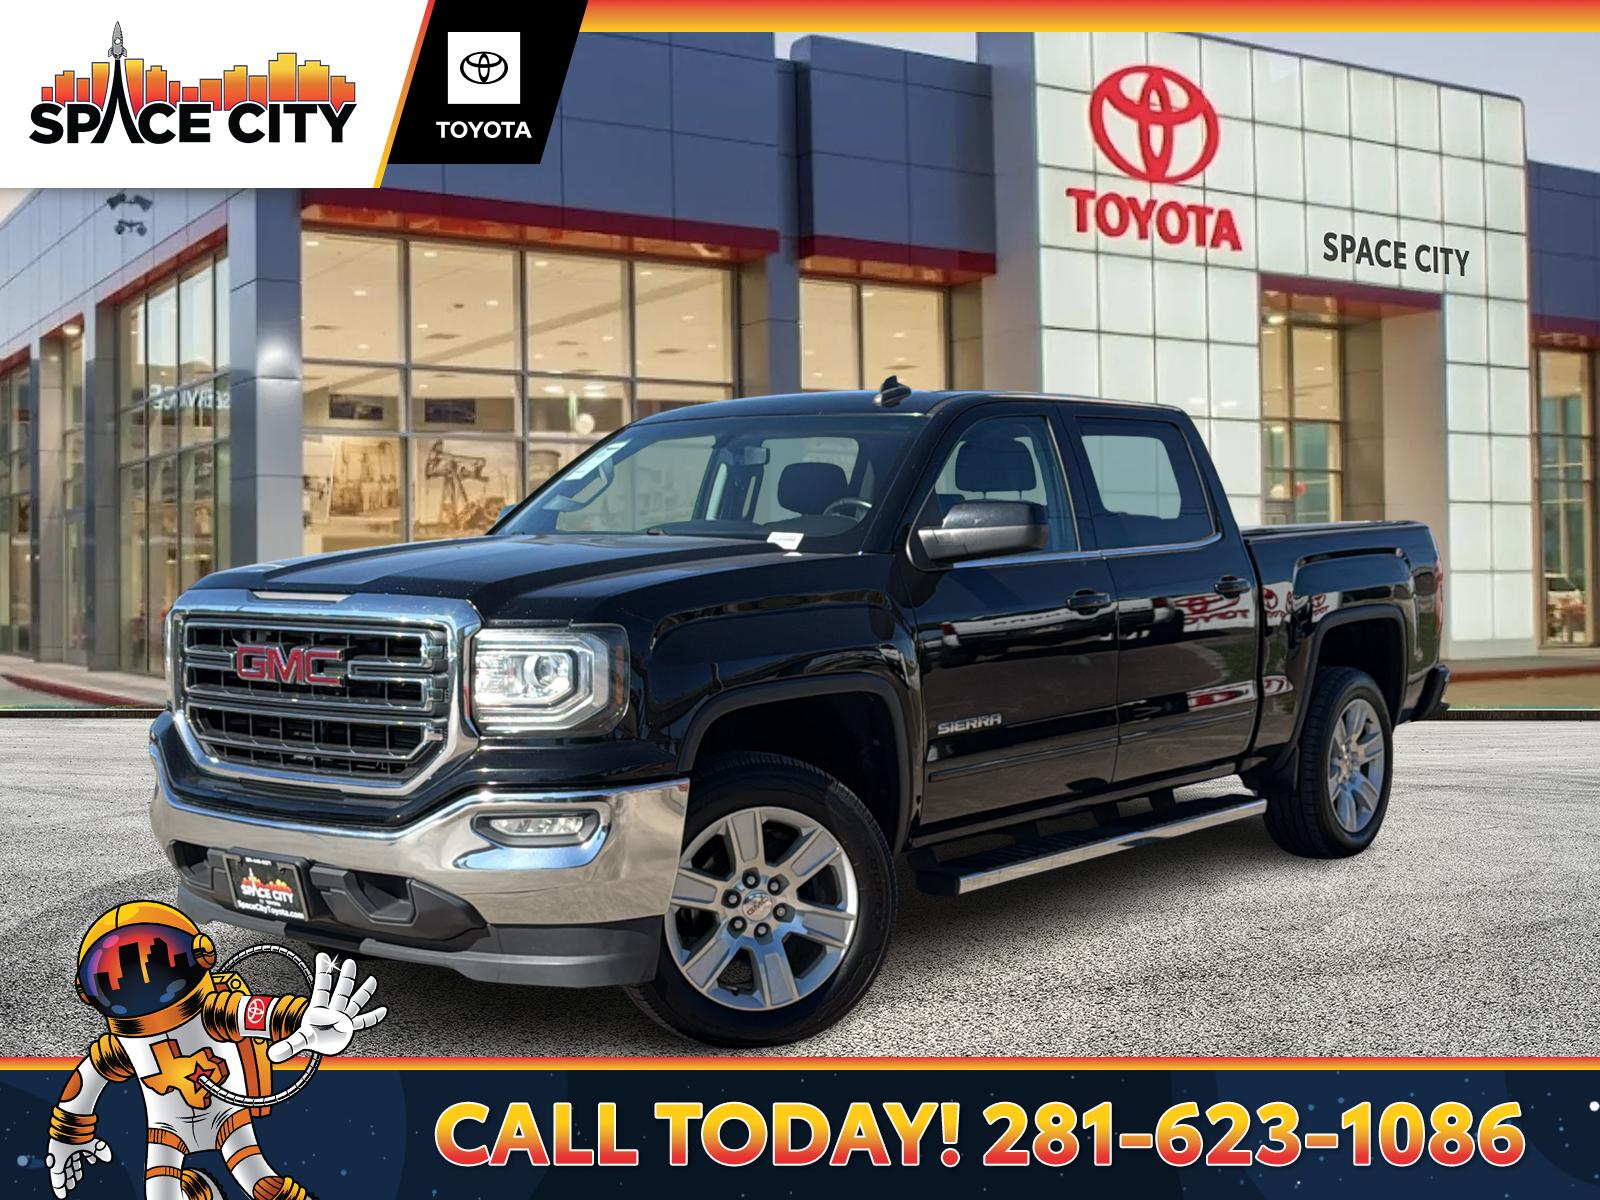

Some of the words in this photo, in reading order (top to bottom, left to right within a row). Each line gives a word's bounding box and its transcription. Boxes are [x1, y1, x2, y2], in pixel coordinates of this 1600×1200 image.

[1066, 188, 1242, 250] TOYOTA
[1323, 232, 1407, 270] SPACE
[1414, 244, 1470, 277] CITY
[236, 646, 342, 686] GMC
[937, 714, 1002, 735] SIERRA
[240, 883, 272, 899] SPACE
[272, 890, 294, 904] CITY
[747, 896, 768, 916] GMC
